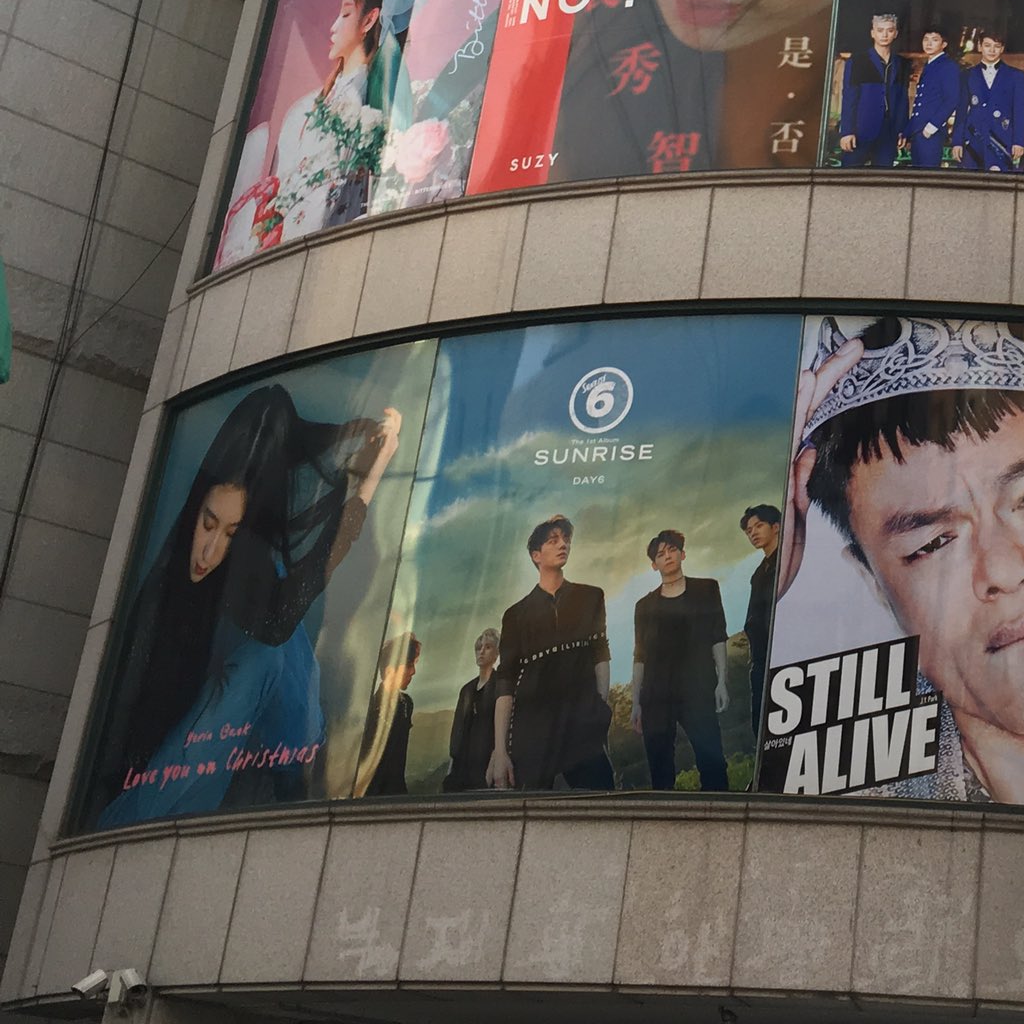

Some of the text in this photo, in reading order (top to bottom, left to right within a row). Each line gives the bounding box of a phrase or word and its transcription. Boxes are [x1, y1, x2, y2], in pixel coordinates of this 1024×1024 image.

[509, 152, 560, 172] SUZY
[533, 443, 655, 466] SUNRISE
[572, 475, 606, 486] DAY6
[767, 642, 911, 735] STILL
[122, 741, 320, 792] Love you on Christmas
[783, 704, 939, 795] ALIVE
